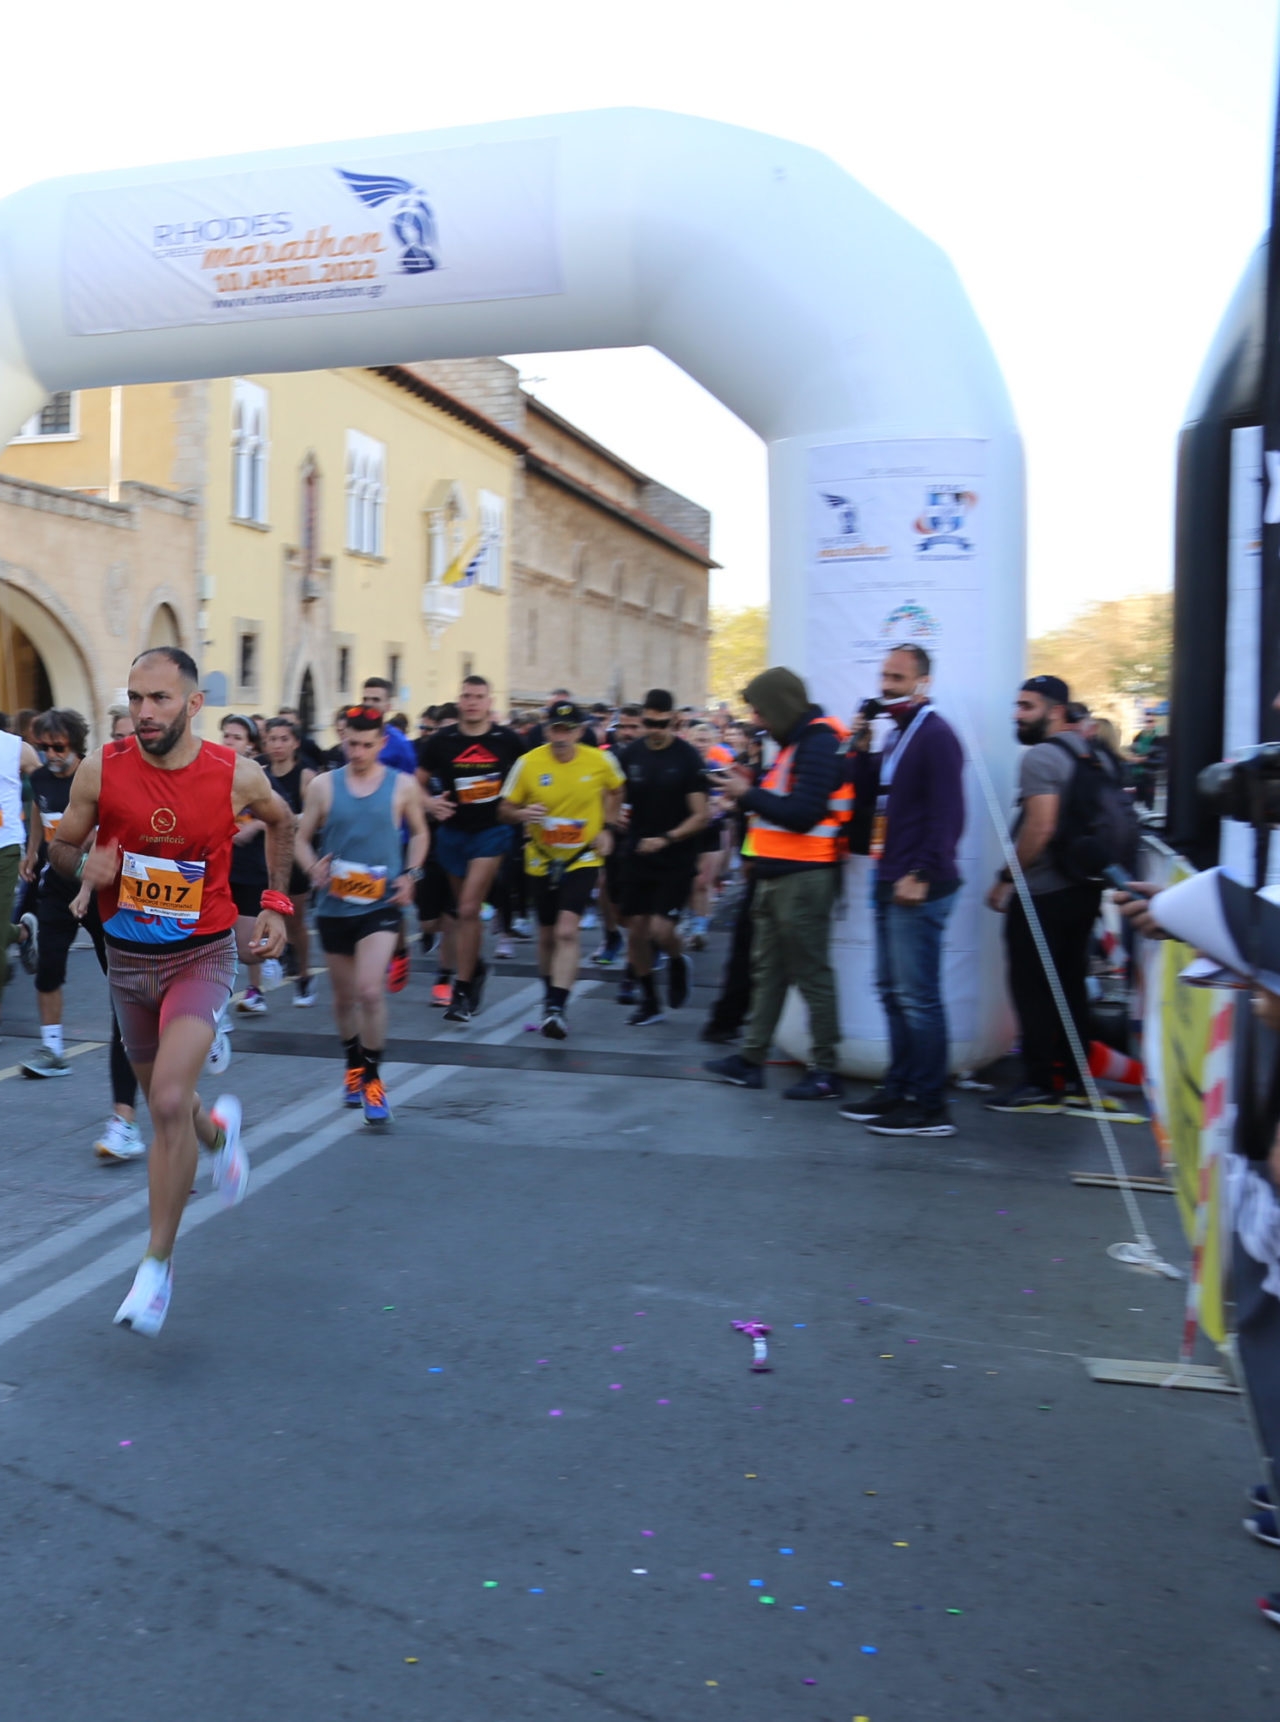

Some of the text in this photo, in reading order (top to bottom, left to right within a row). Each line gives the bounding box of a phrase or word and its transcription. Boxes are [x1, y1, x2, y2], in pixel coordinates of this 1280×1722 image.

[153, 210, 294, 248] RHODES
[200, 224, 389, 270] marathon
[135, 880, 191, 903] 1017
